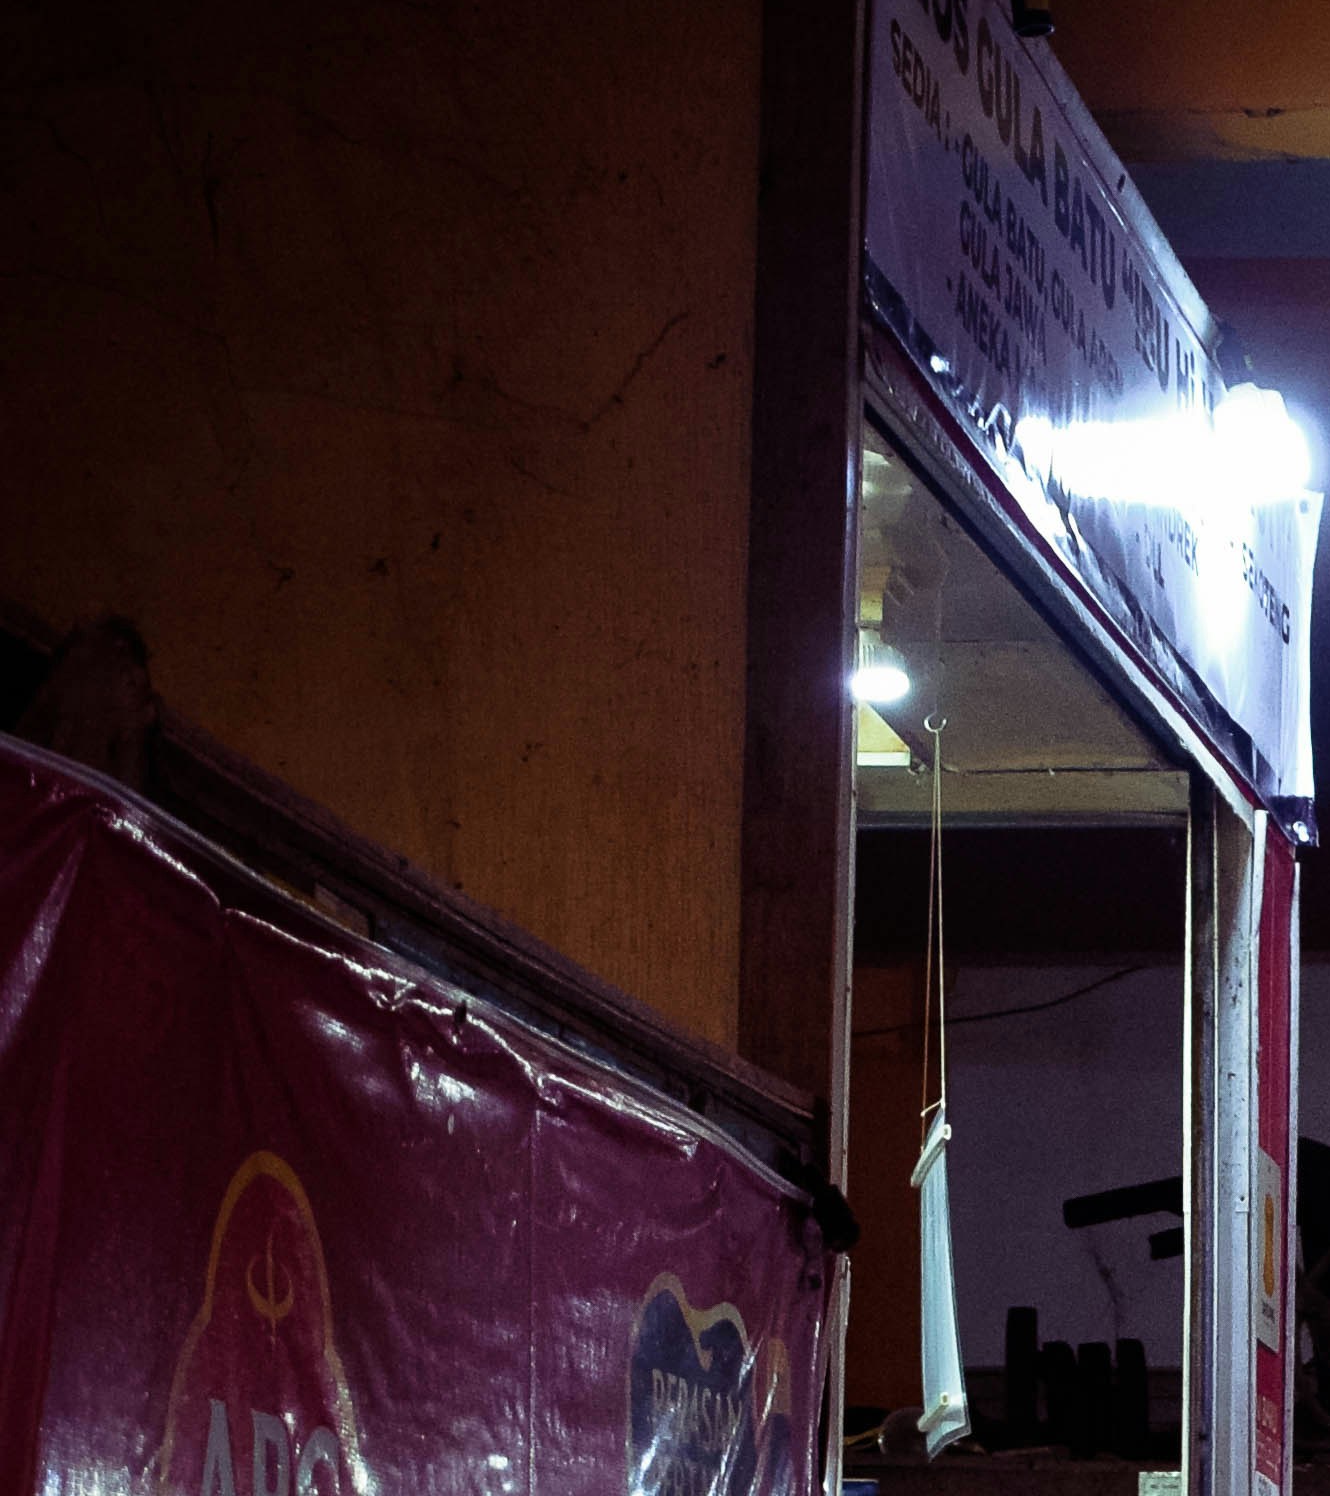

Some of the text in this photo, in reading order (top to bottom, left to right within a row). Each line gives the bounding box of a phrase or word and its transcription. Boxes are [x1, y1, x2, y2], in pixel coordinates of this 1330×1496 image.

[961, 133, 1003, 235] GULA
[976, 17, 1048, 208] GULA
[1054, 131, 1117, 311] BATU
[959, 200, 1001, 302] GULA
